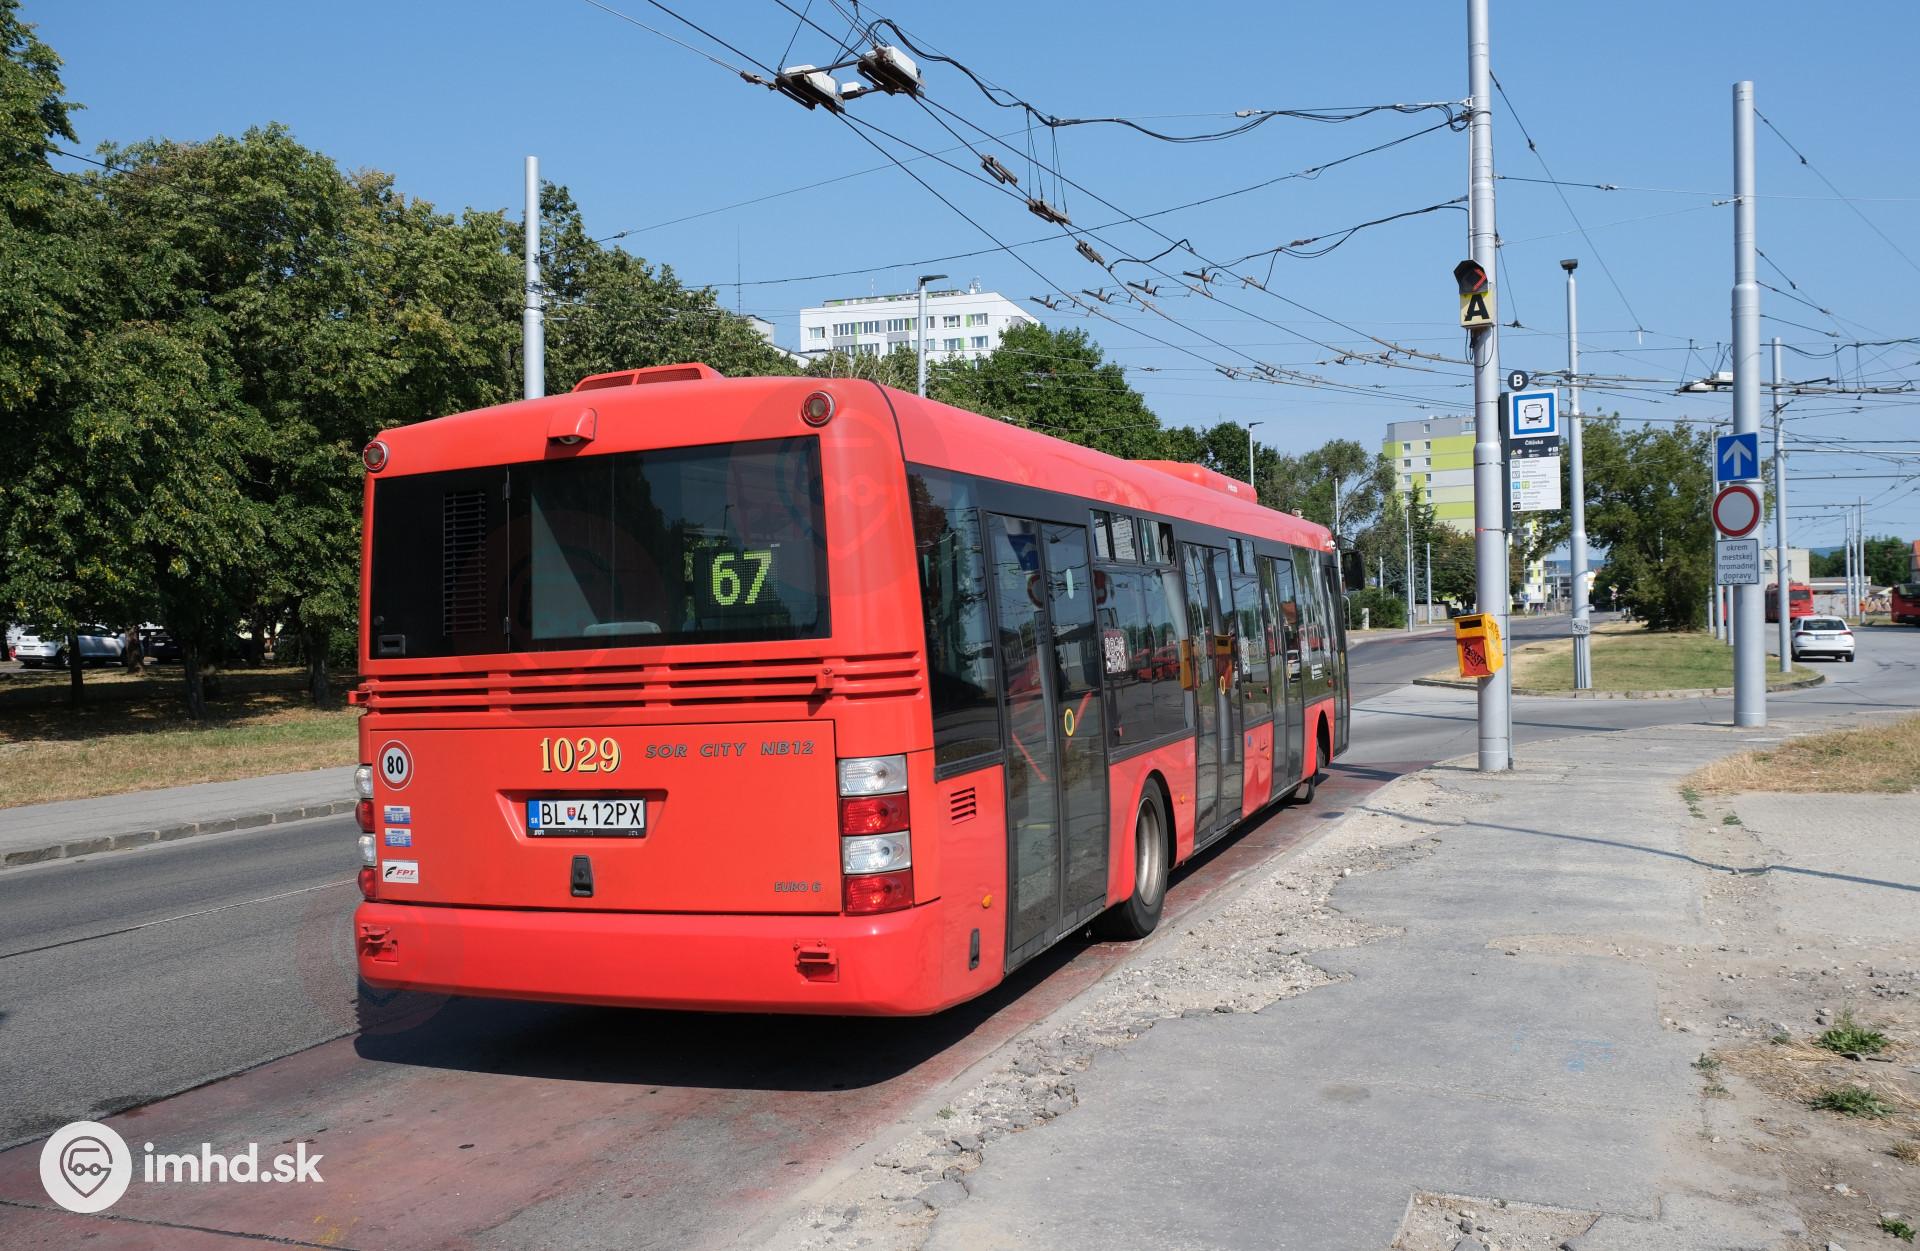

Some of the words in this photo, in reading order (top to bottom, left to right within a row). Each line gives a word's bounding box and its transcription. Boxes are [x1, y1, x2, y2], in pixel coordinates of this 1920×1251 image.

[1464, 293, 1490, 321] A
[1513, 374, 1524, 387] B
[1721, 553, 1753, 561] mestskej
[712, 550, 772, 606] 67
[1724, 572, 1751, 580] dopravy
[540, 737, 622, 773] 1029
[645, 744, 688, 759] SOR
[700, 742, 748, 757] CITY
[760, 740, 815, 756] NB12
[387, 755, 405, 775] 80
[396, 869, 416, 877] FPT
[774, 881, 809, 893] EURO
[811, 881, 822, 893] 6
